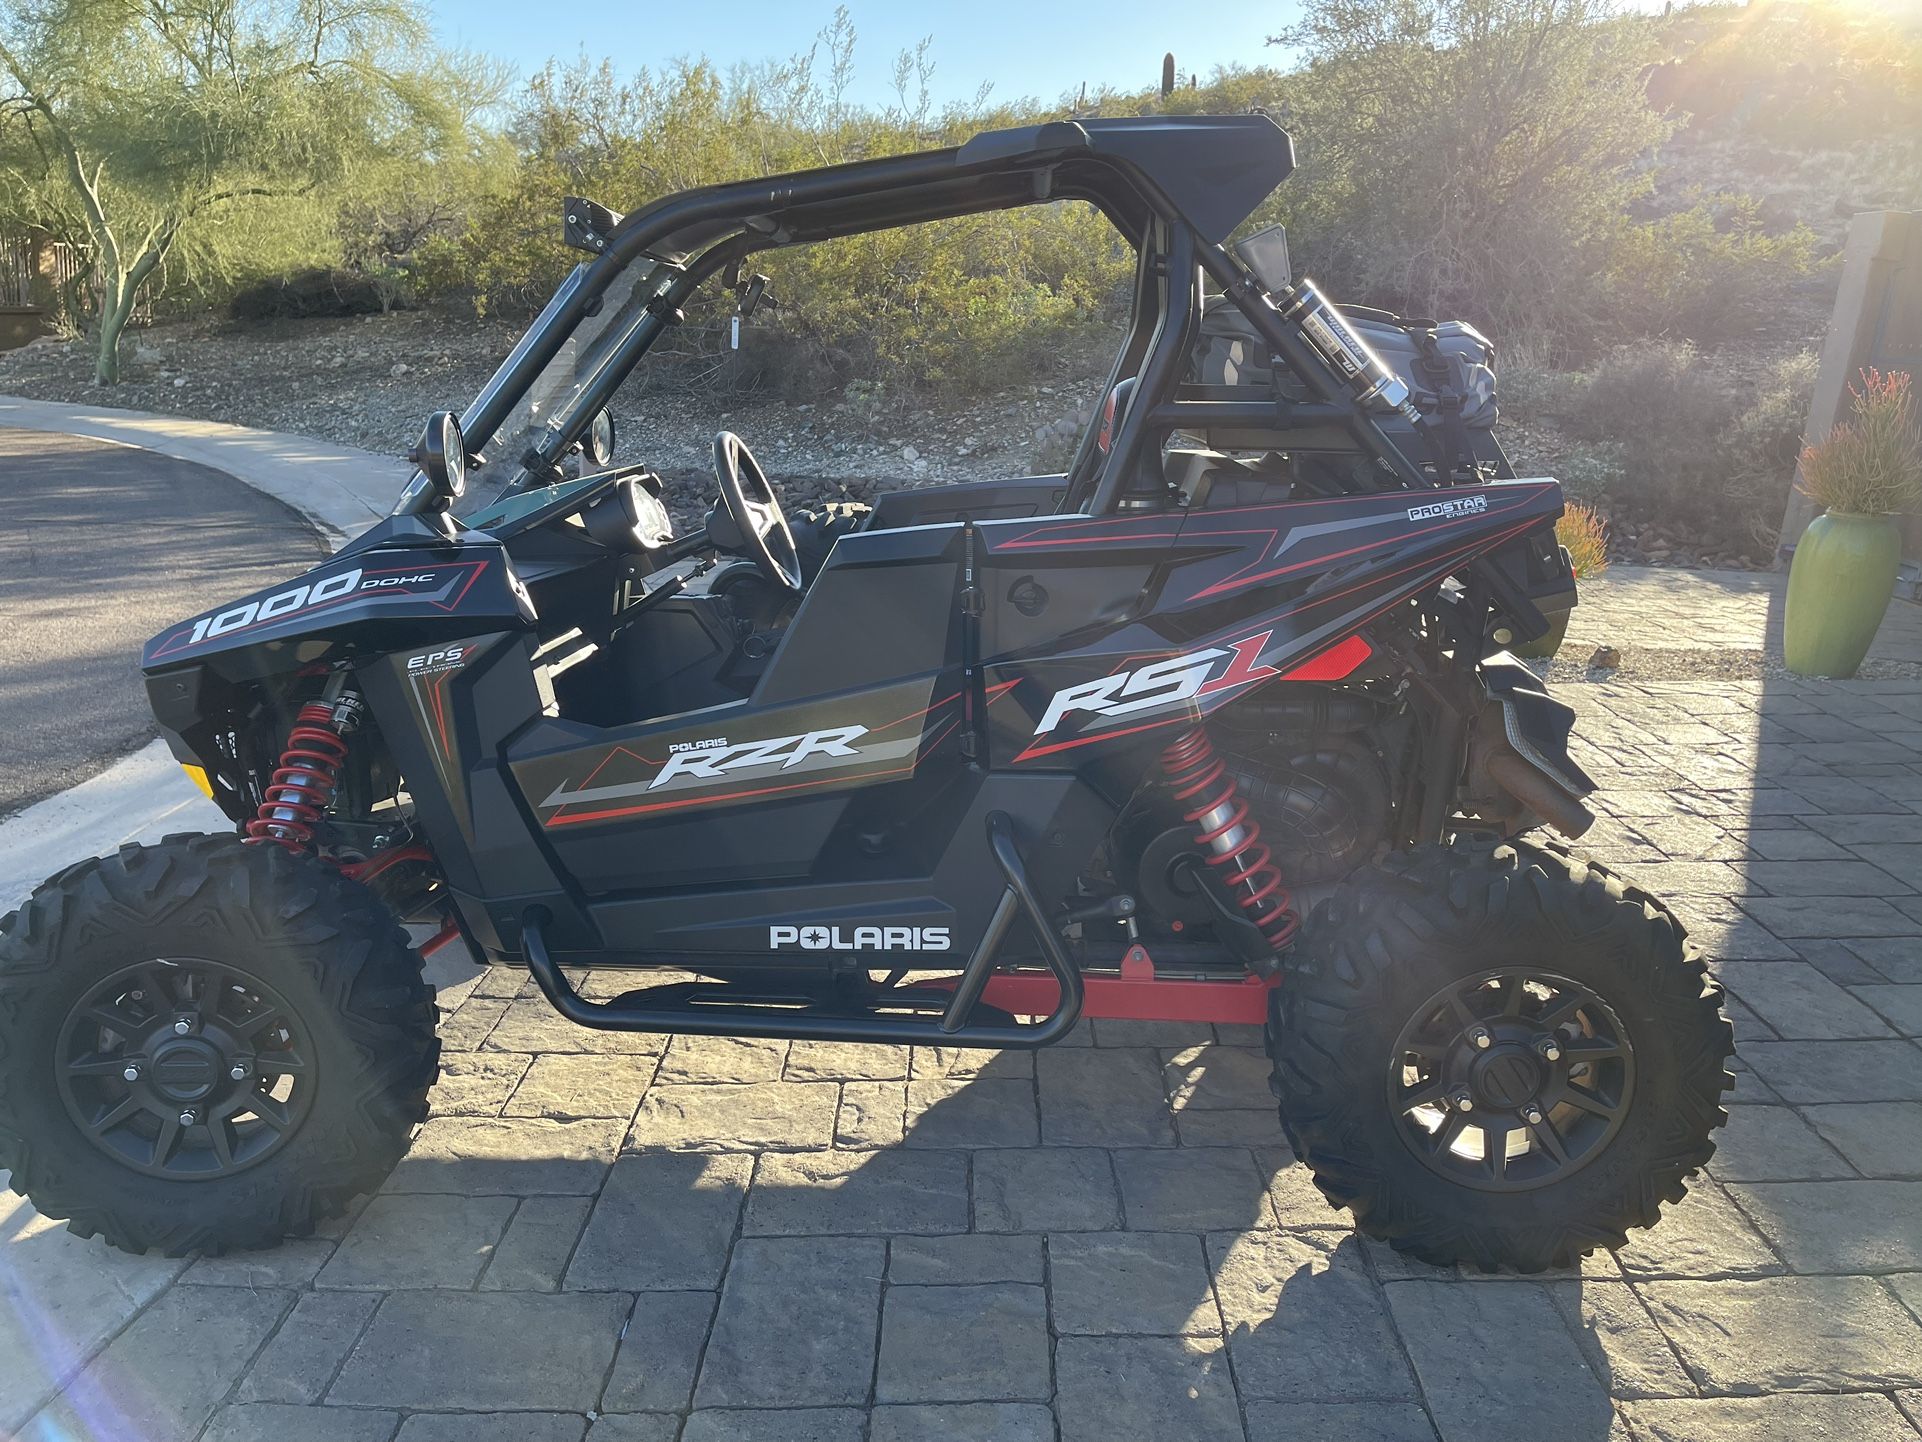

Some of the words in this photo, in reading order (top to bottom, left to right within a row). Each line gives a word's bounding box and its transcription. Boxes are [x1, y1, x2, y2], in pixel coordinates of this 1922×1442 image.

[1408, 496, 1487, 520] PROSTAR
[1446, 508, 1486, 519] ENGINES
[189, 568, 363, 644] 1000
[360, 573, 436, 590] DOHC
[407, 647, 464, 669] EPS
[1033, 629, 1282, 736] RS1
[669, 737, 728, 753] POLARIS
[646, 725, 870, 790] RZR
[770, 926, 951, 950] POLARIS
